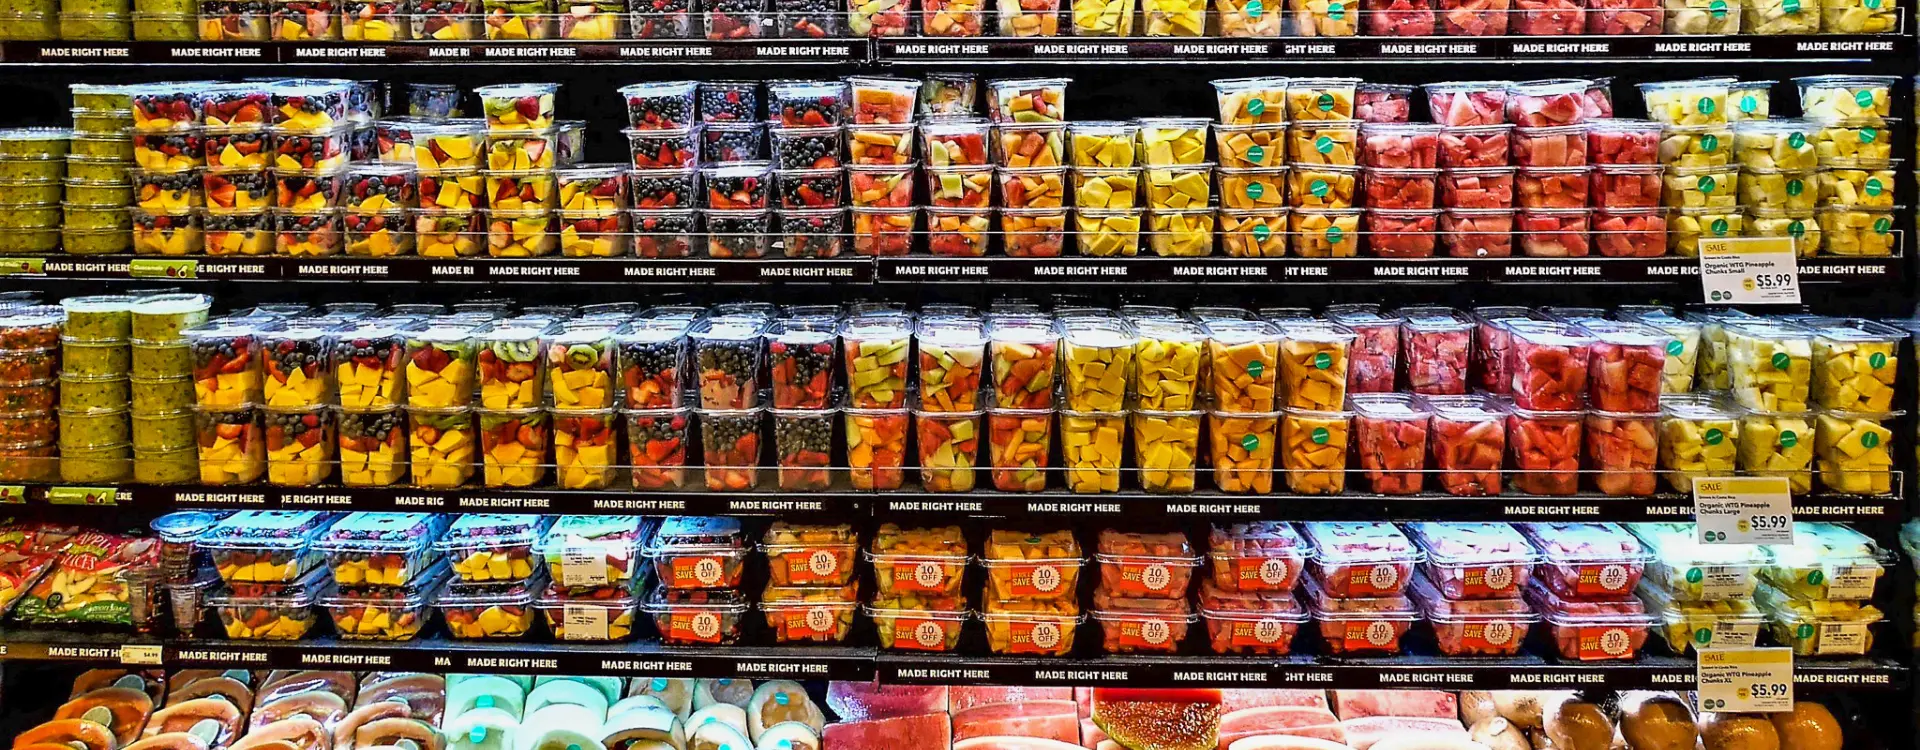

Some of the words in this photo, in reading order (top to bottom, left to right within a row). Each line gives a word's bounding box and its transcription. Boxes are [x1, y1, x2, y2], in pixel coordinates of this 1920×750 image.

[896, 44, 926, 54] MADE
[928, 44, 960, 54] RIGHT
[962, 44, 988, 54] HERE
[1174, 44, 1205, 54] MADE
[1207, 44, 1239, 54] RIGHT
[1241, 44, 1268, 54] HERE
[1382, 44, 1412, 54] MADE
[1414, 44, 1447, 54] RIGHT
[1449, 44, 1476, 54] HERE
[1797, 42, 1828, 51] MADE
[1830, 41, 1863, 51] RIGHT
[1865, 41, 1893, 51] HERE
[42, 48, 70, 57] MADE
[72, 47, 102, 57] RIGHT
[103, 48, 128, 57] HERE
[172, 48, 200, 57] MADE
[202, 48, 233, 57] RIGHT
[235, 48, 260, 57] HERE
[486, 47, 515, 57] MADE
[517, 47, 548, 57] RIGHT
[550, 47, 576, 57] HERE
[621, 47, 650, 57] MADE
[652, 47, 684, 57] RIGHT
[683, 47, 712, 56] HERE
[1706, 243, 1727, 252] SALE
[45, 263, 74, 272] MADE
[76, 264, 105, 273] RIGHT
[206, 265, 238, 273] RIGHT
[239, 265, 264, 273] HERE
[299, 265, 328, 274] MADE
[330, 265, 361, 274] RIGHT
[363, 265, 388, 274] HERE
[1705, 262, 1728, 270] Organic
[1745, 260, 1775, 268] Pineapple
[625, 267, 654, 276] MADE
[656, 267, 687, 276] RIGHT
[690, 267, 715, 276] HERE
[761, 267, 790, 276] MADE
[793, 267, 824, 277] RIGHT
[827, 267, 852, 277] HERE
[1035, 266, 1064, 275] MADE
[1067, 266, 1098, 275] RIGHT
[1101, 266, 1127, 275] HERE
[1374, 266, 1405, 276] MADE
[1407, 266, 1439, 276] RIGHT
[1442, 266, 1468, 276] HERE
[1506, 266, 1536, 276] MADE
[1539, 266, 1571, 276] RIGHT
[1574, 266, 1600, 275] HERE
[1756, 273, 1791, 287] $5.99
[1701, 482, 1722, 491] SALE
[176, 493, 204, 502] MADE
[207, 493, 237, 503] RIGHT
[239, 494, 264, 503] HERE
[460, 497, 489, 507] MADE
[491, 498, 521, 507] RIGHT
[524, 498, 549, 508] HERE
[730, 500, 759, 510] MADE
[762, 501, 793, 510] RIGHT
[796, 501, 821, 510] HERE
[1028, 503, 1058, 512] MADE
[1060, 503, 1092, 512] RIGHT
[1094, 503, 1120, 512] HERE
[1167, 504, 1197, 513] MADE
[1200, 504, 1231, 513] RIGHT
[1234, 504, 1260, 513] HERE
[1740, 501, 1771, 509] Pineapple
[1505, 506, 1535, 515] MADE
[1538, 506, 1570, 515] RIGHT
[1573, 506, 1599, 515] HERE
[1751, 515, 1787, 529] $5.99
[676, 571, 693, 579] SAVE
[701, 570, 716, 578] OFF
[1240, 571, 1258, 579] SAVE
[1266, 570, 1282, 578] OFF
[1350, 576, 1368, 584] SAVE
[1465, 576, 1483, 584] SAVE
[1235, 628, 1252, 636] SAVE
[1581, 642, 1599, 650] SAVE
[49, 647, 78, 657] MADE
[80, 648, 110, 658] RIGHT
[179, 650, 208, 660] MADE
[210, 651, 240, 661] RIGHT
[242, 652, 267, 662] HERE
[1704, 653, 1724, 662] SALE
[303, 654, 331, 663] MADE
[333, 654, 363, 664] RIGHT
[365, 655, 390, 665] HERE
[602, 660, 631, 670] MADE
[633, 661, 664, 670] RIGHT
[667, 661, 692, 671] HERE
[898, 669, 927, 678] MADE
[930, 669, 961, 678] RIGHT
[964, 669, 989, 679] HERE
[1380, 673, 1410, 683] MADE
[1413, 673, 1444, 683] RIGHT
[1447, 673, 1473, 683] HERE
[1794, 674, 1825, 683] MADE
[1827, 674, 1859, 683] RIGHT
[1862, 674, 1888, 683] HERE
[1751, 683, 1787, 697] $5.99
